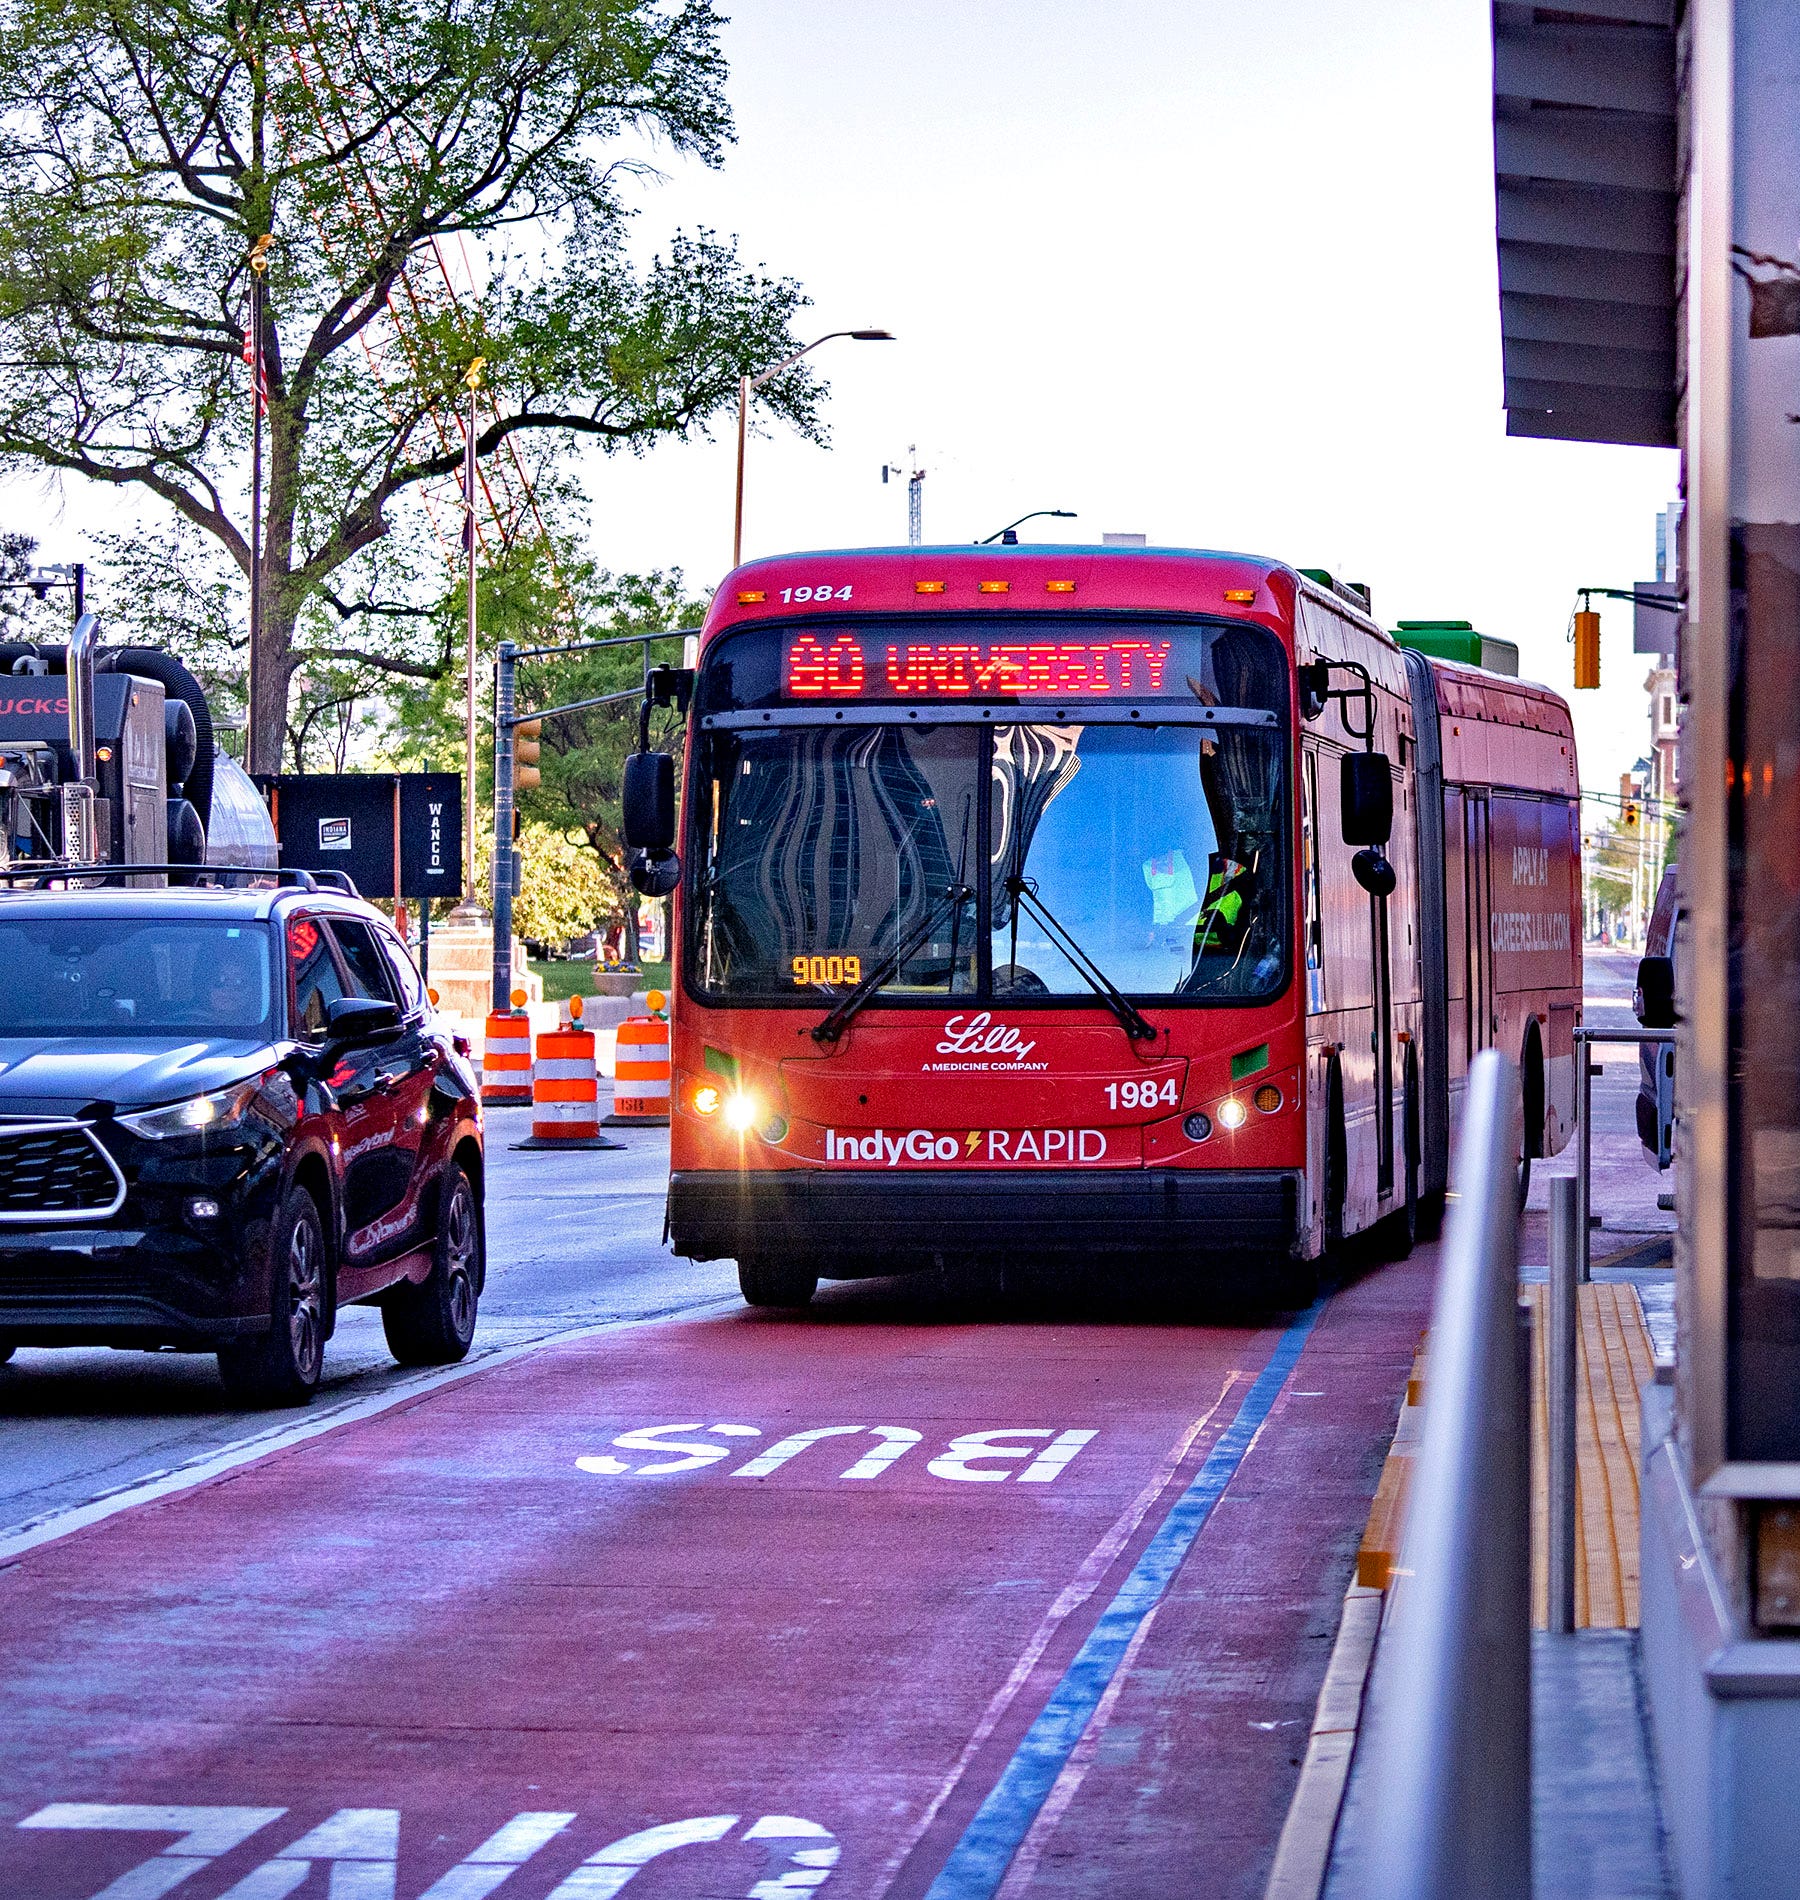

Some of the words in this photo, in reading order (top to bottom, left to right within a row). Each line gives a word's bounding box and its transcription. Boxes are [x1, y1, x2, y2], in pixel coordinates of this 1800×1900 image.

[779, 584, 854, 604] 1984
[887, 641, 1172, 691] UNIVERSITY
[428, 803, 443, 866] WANCO
[1512, 847, 1538, 886] APPLY
[1539, 848, 1549, 886] AT
[792, 956, 861, 985] 9009
[936, 1011, 1036, 1060] Lilly
[921, 1063, 931, 1071] A
[932, 1062, 989, 1071] MEDICINE
[991, 1062, 1049, 1071] COMPANY
[1104, 1079, 1178, 1110] 1984
[826, 1129, 959, 1166] IndyGo
[989, 1130, 1107, 1161] RAPID
[575, 1424, 1099, 1482] BUS
